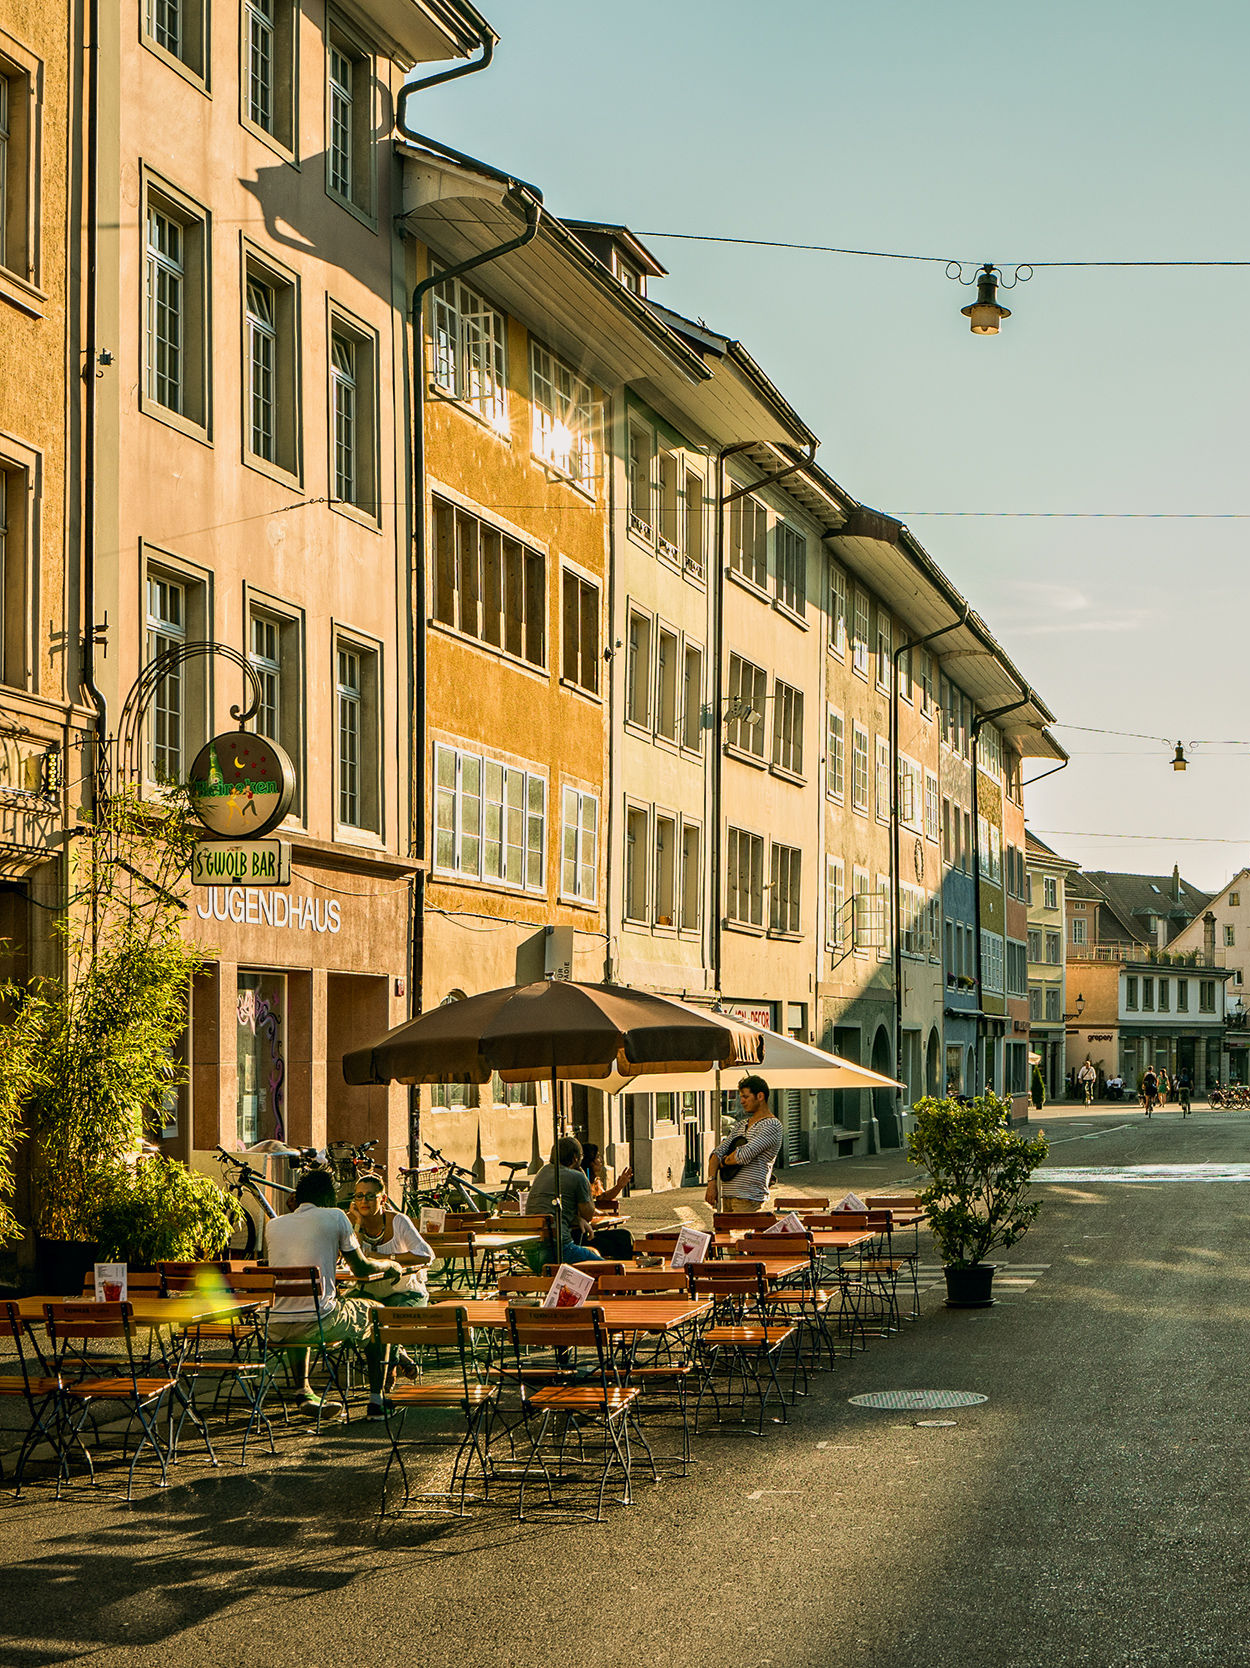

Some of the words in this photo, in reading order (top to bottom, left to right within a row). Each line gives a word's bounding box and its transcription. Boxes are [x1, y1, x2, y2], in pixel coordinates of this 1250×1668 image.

[195, 778, 279, 797] Heineken
[251, 850, 276, 877] BAR
[196, 886, 341, 934] JUGENDHAUS
